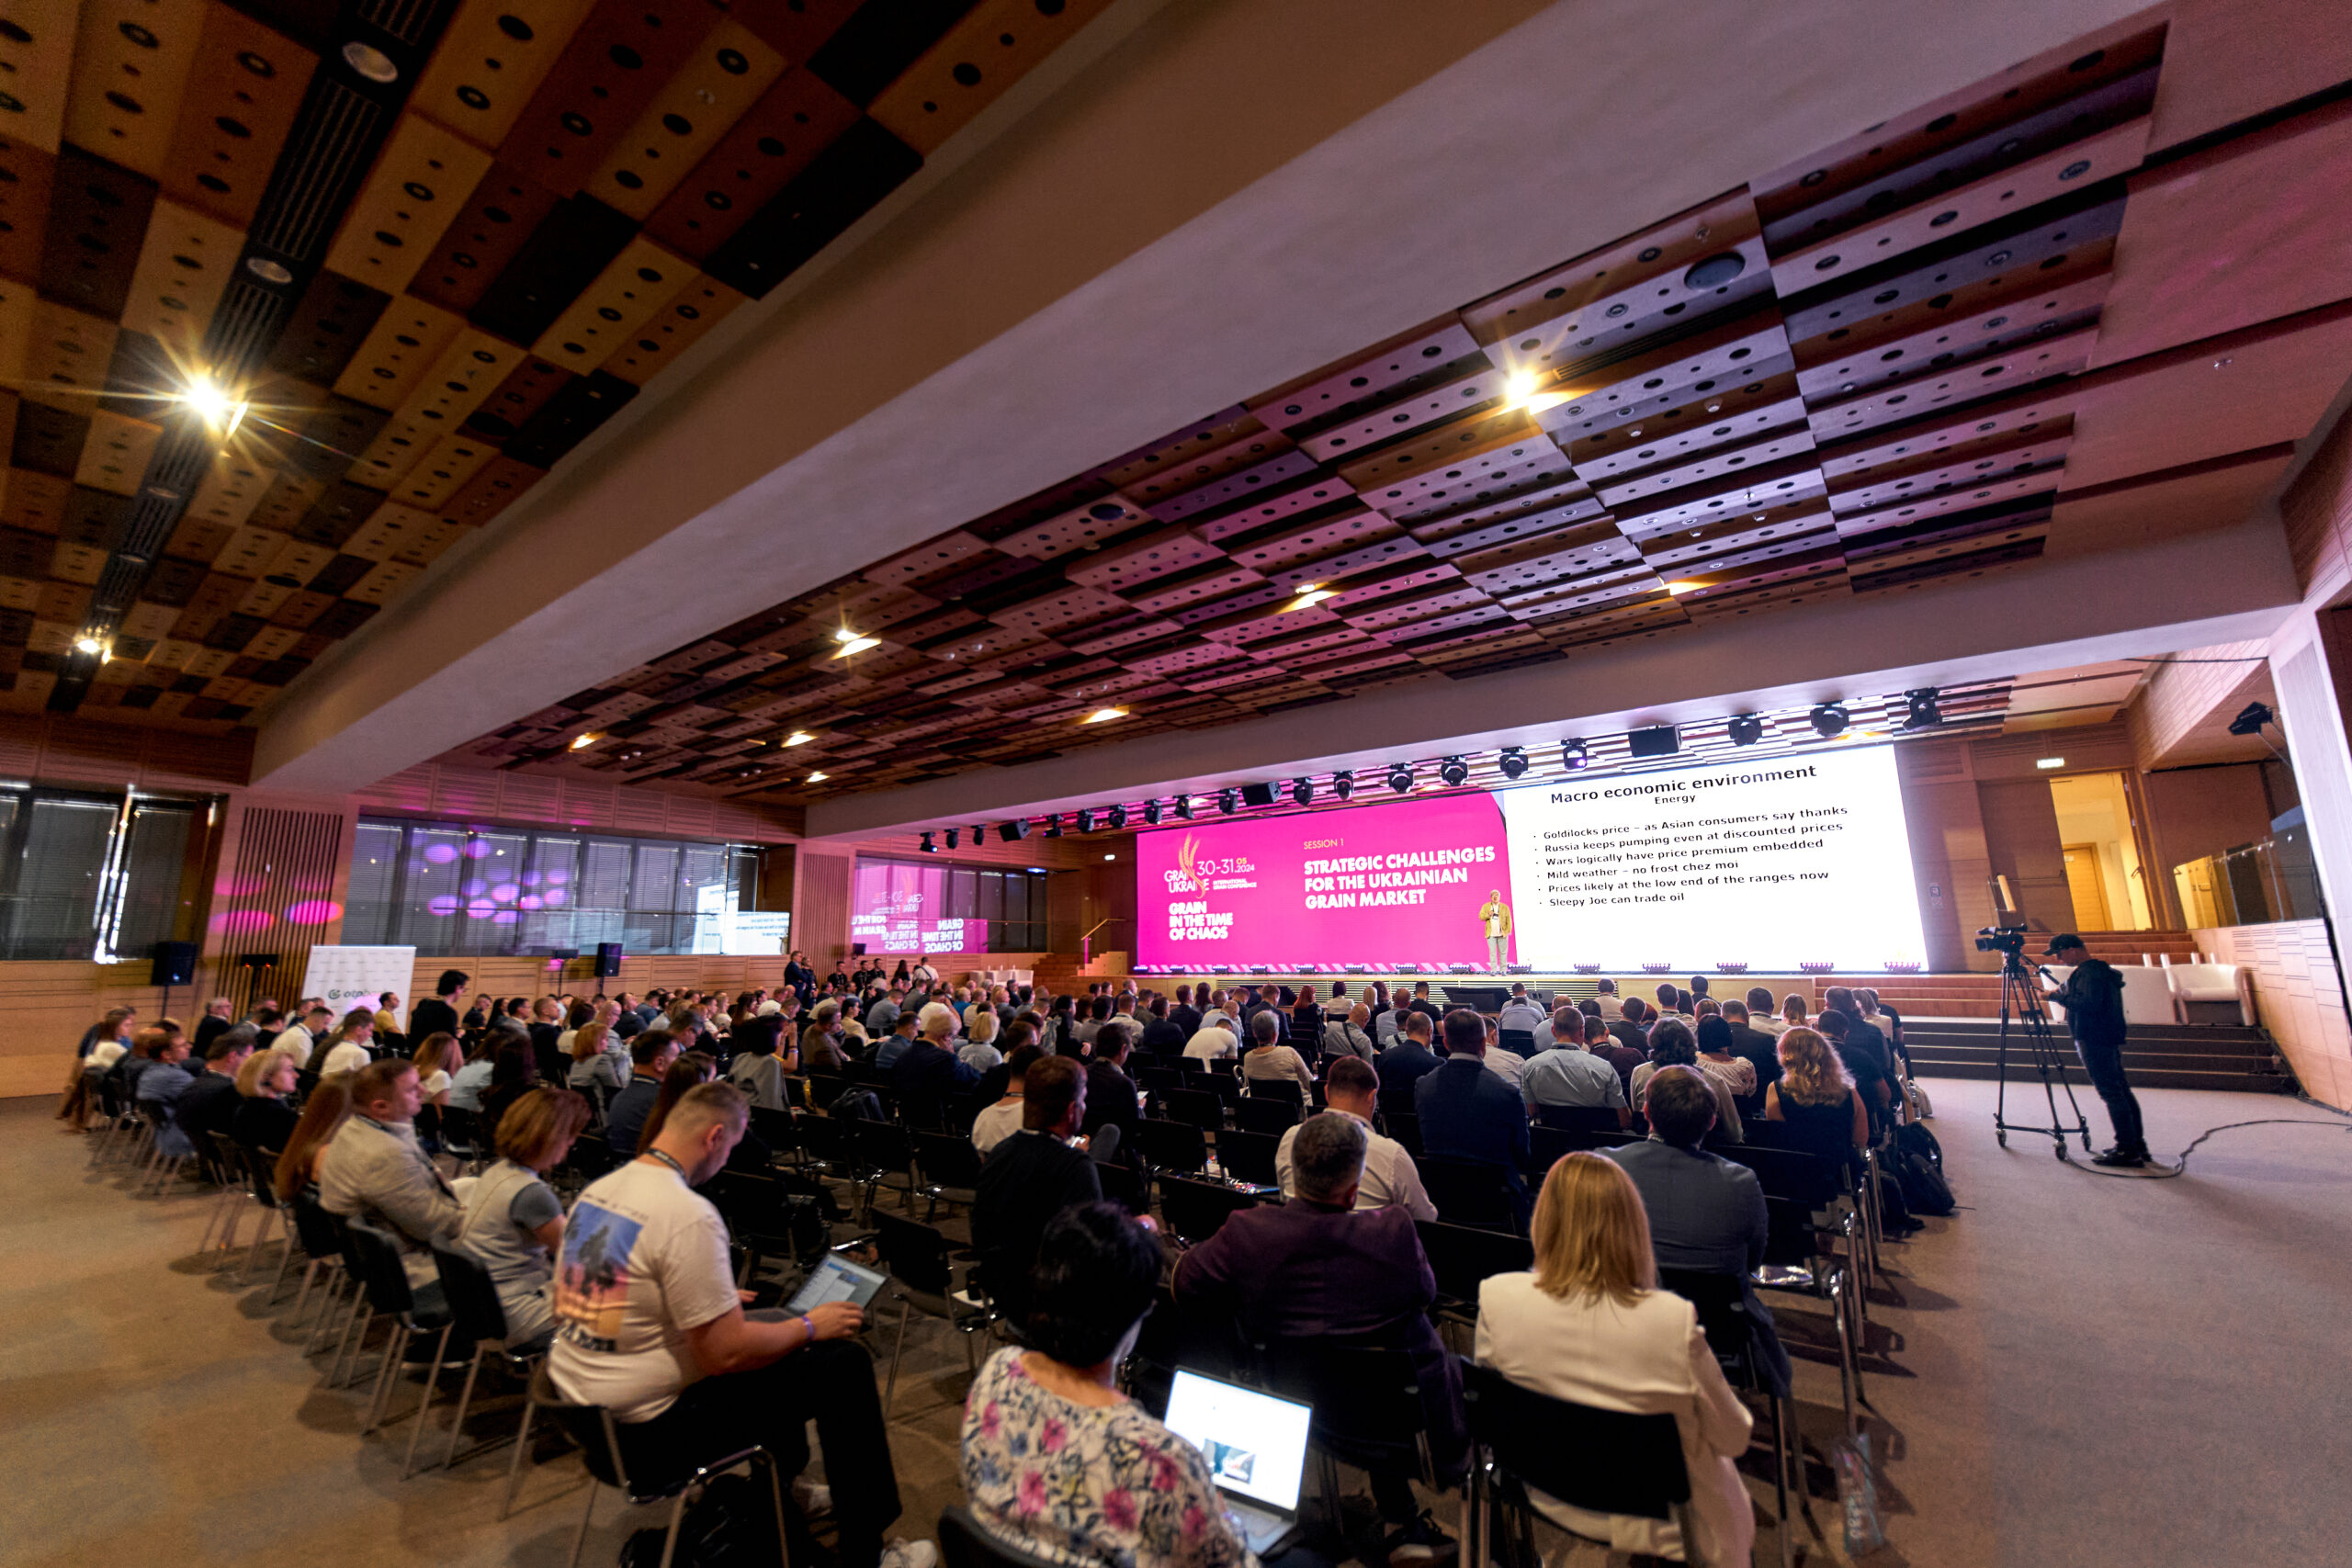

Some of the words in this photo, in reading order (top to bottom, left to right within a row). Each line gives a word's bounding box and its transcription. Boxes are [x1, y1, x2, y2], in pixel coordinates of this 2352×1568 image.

[1551, 791, 1599, 804] Macro
[1604, 780, 1686, 798] economic
[1692, 765, 1817, 789] environment
[1655, 795, 1696, 805] Energy
[1544, 828, 1599, 839] Goldilocks
[1602, 826, 1630, 835] price
[1661, 820, 1694, 829] Asian
[1699, 814, 1768, 826] consumers
[1772, 812, 1794, 820] say
[1800, 807, 1848, 818] thanks
[1304, 839, 1338, 850] SESSION
[1340, 838, 1344, 846] 1
[1545, 843, 1579, 852] Russia
[1583, 841, 1615, 850] keeps
[1619, 837, 1669, 848] pumping
[1674, 834, 1702, 842] even
[1724, 826, 1795, 839] discounted
[1801, 823, 1843, 835] prices
[1304, 855, 1383, 875] STRATEGIC
[1385, 846, 1496, 869] CHALLENGES
[1577, 853, 1622, 864] logically
[1626, 852, 1654, 860] have
[1657, 850, 1688, 860] price
[1691, 845, 1747, 858] premium
[1753, 839, 1823, 852] embedded
[1305, 876, 1335, 892] FOR
[1337, 874, 1365, 890] THE
[1368, 867, 1468, 888] UKRAINIAN
[1547, 871, 1569, 879] Mild
[1572, 868, 1618, 877] weather
[1651, 864, 1679, 873] frost
[1683, 863, 1711, 871] chez
[1715, 860, 1738, 869] moi
[1548, 884, 1581, 892] Prices
[1584, 882, 1614, 891] likely
[1633, 880, 1652, 888] the
[1655, 879, 1676, 887] low
[1680, 877, 1703, 886] end
[1707, 875, 1719, 885] of
[1724, 875, 1745, 884] the
[1749, 874, 1795, 884] ranges
[1800, 872, 1828, 880] now
[1169, 901, 1207, 915] GRAIN
[1305, 893, 1356, 909] GRAIN
[1359, 888, 1426, 907] MARKET
[1549, 898, 1585, 907] Sleepy
[1634, 894, 1666, 902] trade
[1669, 892, 1684, 901] oil
[1170, 915, 1183, 928] IN
[1183, 914, 1205, 927] THE
[1205, 912, 1234, 926] TIME
[1170, 927, 1186, 941] OF
[1186, 926, 1228, 940] CHAOS
